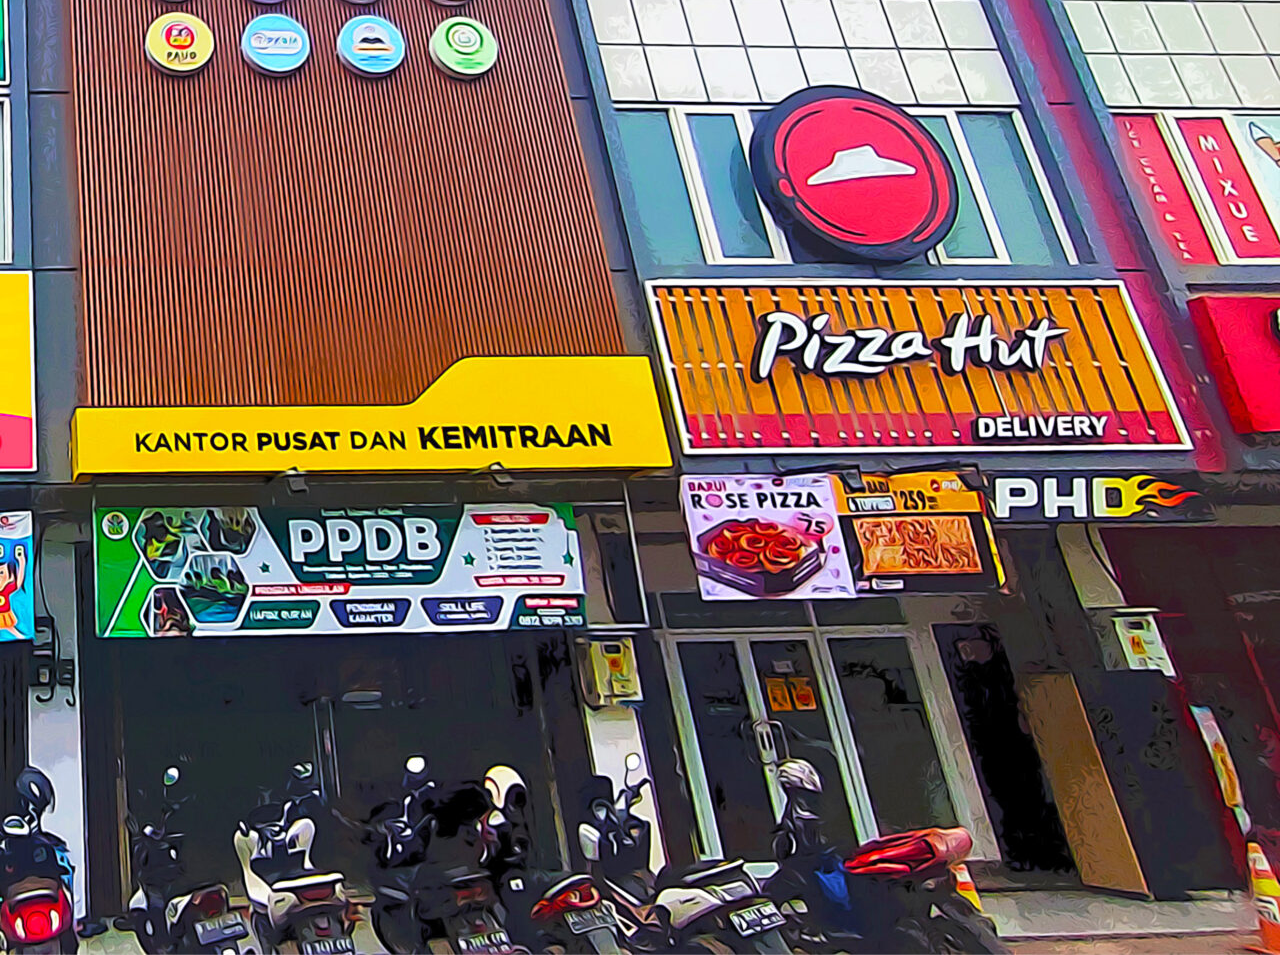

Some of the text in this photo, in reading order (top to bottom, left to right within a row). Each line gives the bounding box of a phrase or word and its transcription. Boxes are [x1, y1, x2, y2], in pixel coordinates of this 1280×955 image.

[1198, 134, 1260, 243] MIXUE
[758, 311, 1069, 378] Pizza Hut
[134, 421, 613, 454] KANTOR PUSAT DAN KEMITRAAN
[979, 416, 1108, 438] DELIVERY
[755, 491, 823, 509] PIZZA
[994, 477, 1144, 519] PHD
[288, 518, 442, 563] PPDB
